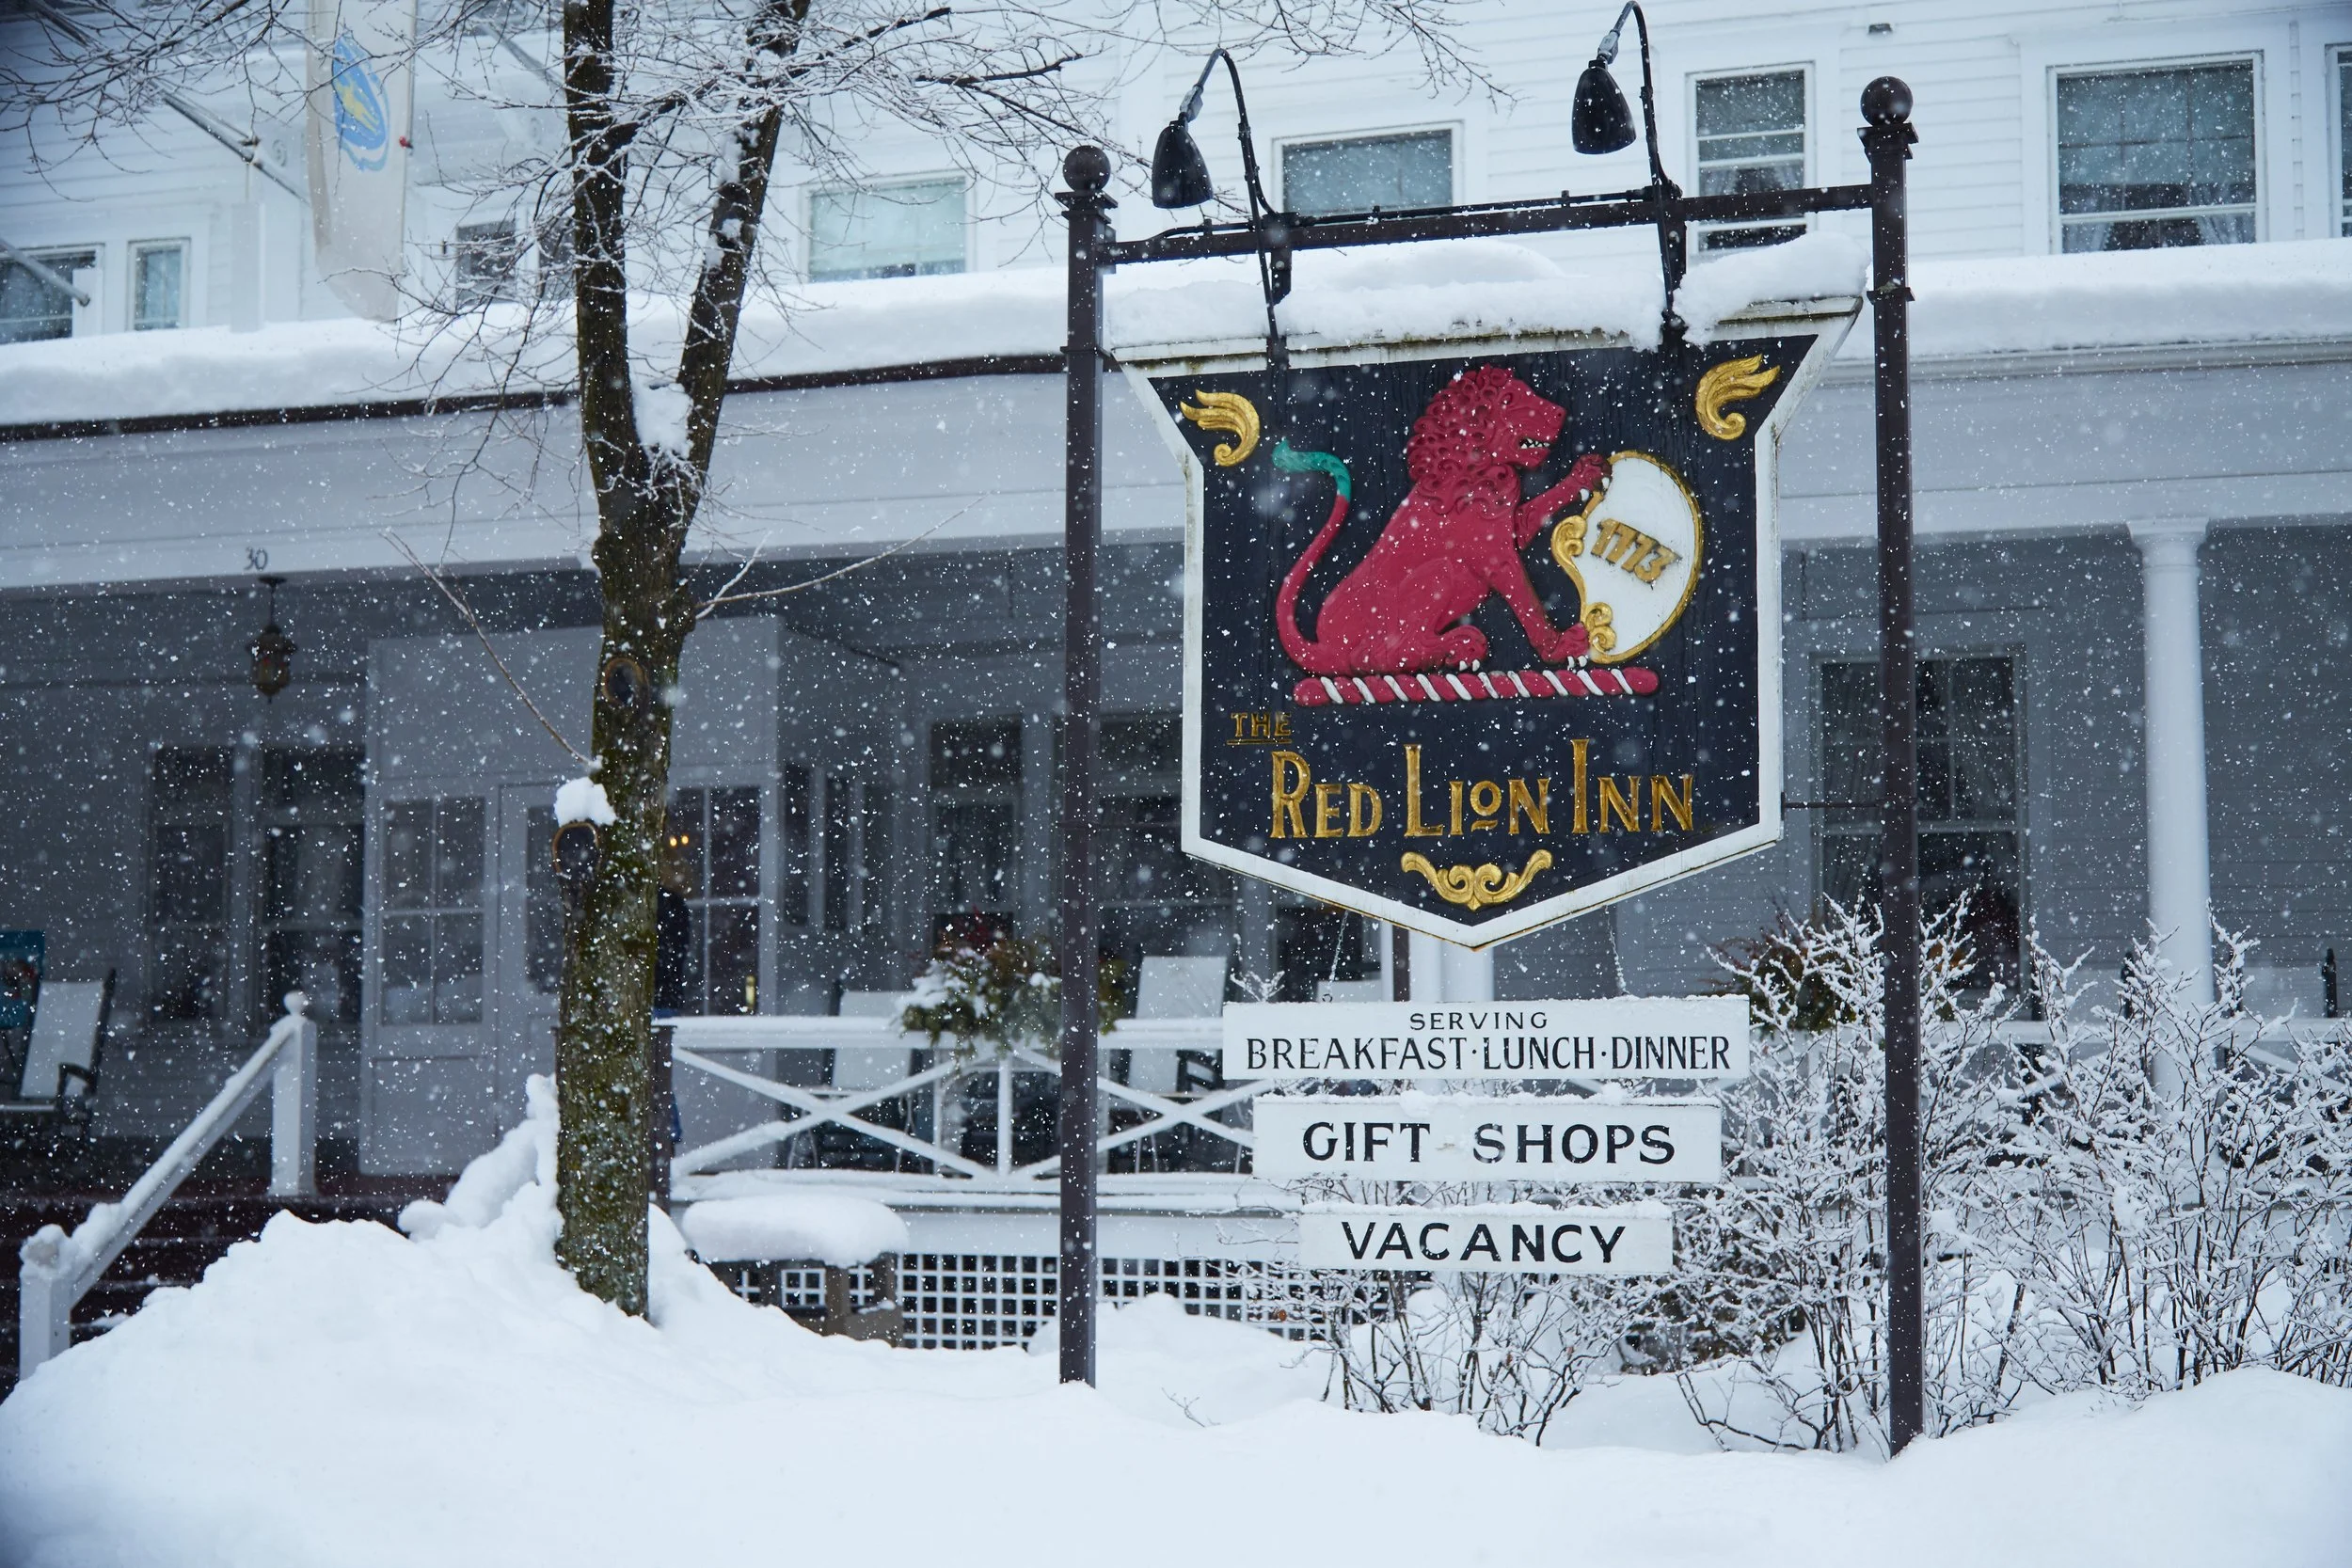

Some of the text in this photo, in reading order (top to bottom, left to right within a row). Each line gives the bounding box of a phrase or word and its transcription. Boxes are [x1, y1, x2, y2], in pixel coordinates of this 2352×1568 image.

[245, 547, 268, 571] 30
[1591, 518, 1682, 583] 1773
[1232, 712, 1293, 737] THE
[1270, 738, 1694, 839] RED LION INN
[1409, 1011, 1549, 1030] SERVING
[1302, 1121, 1676, 1164] GIFT SHOPS
[1341, 1221, 1626, 1263] VACANCY
